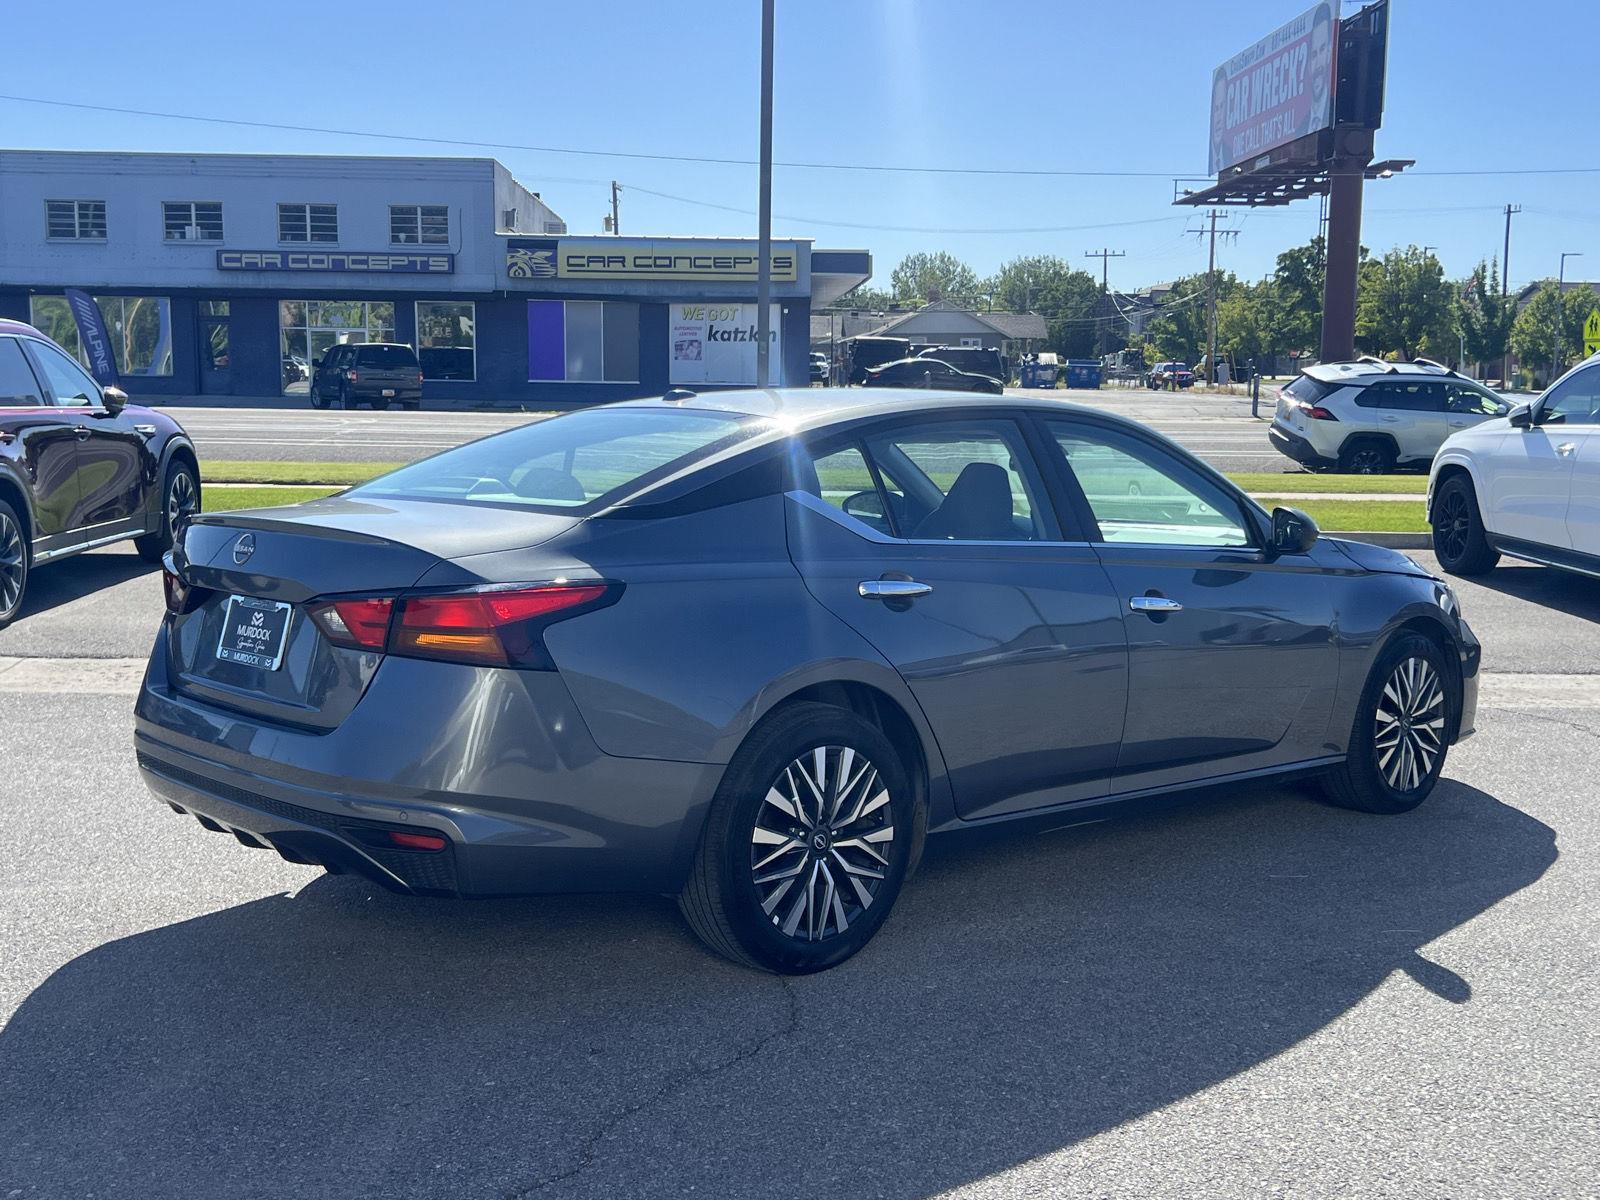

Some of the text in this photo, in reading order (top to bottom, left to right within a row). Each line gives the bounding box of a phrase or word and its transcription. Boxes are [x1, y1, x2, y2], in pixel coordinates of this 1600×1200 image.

[1226, 75, 1249, 130] CAR
[1251, 42, 1308, 117] WRECK?
[1232, 108, 1296, 158] ONE CALL THAT'S ALL
[221, 253, 449, 271] CAR CONCEPTS
[566, 255, 793, 269] CAR CONCEPS
[682, 305, 738, 322] WE GOT
[707, 325, 777, 342] katzkn
[83, 321, 110, 375] ALPINE
[236, 624, 272, 641] MURDOCK
[233, 652, 260, 665] MURDOCK
